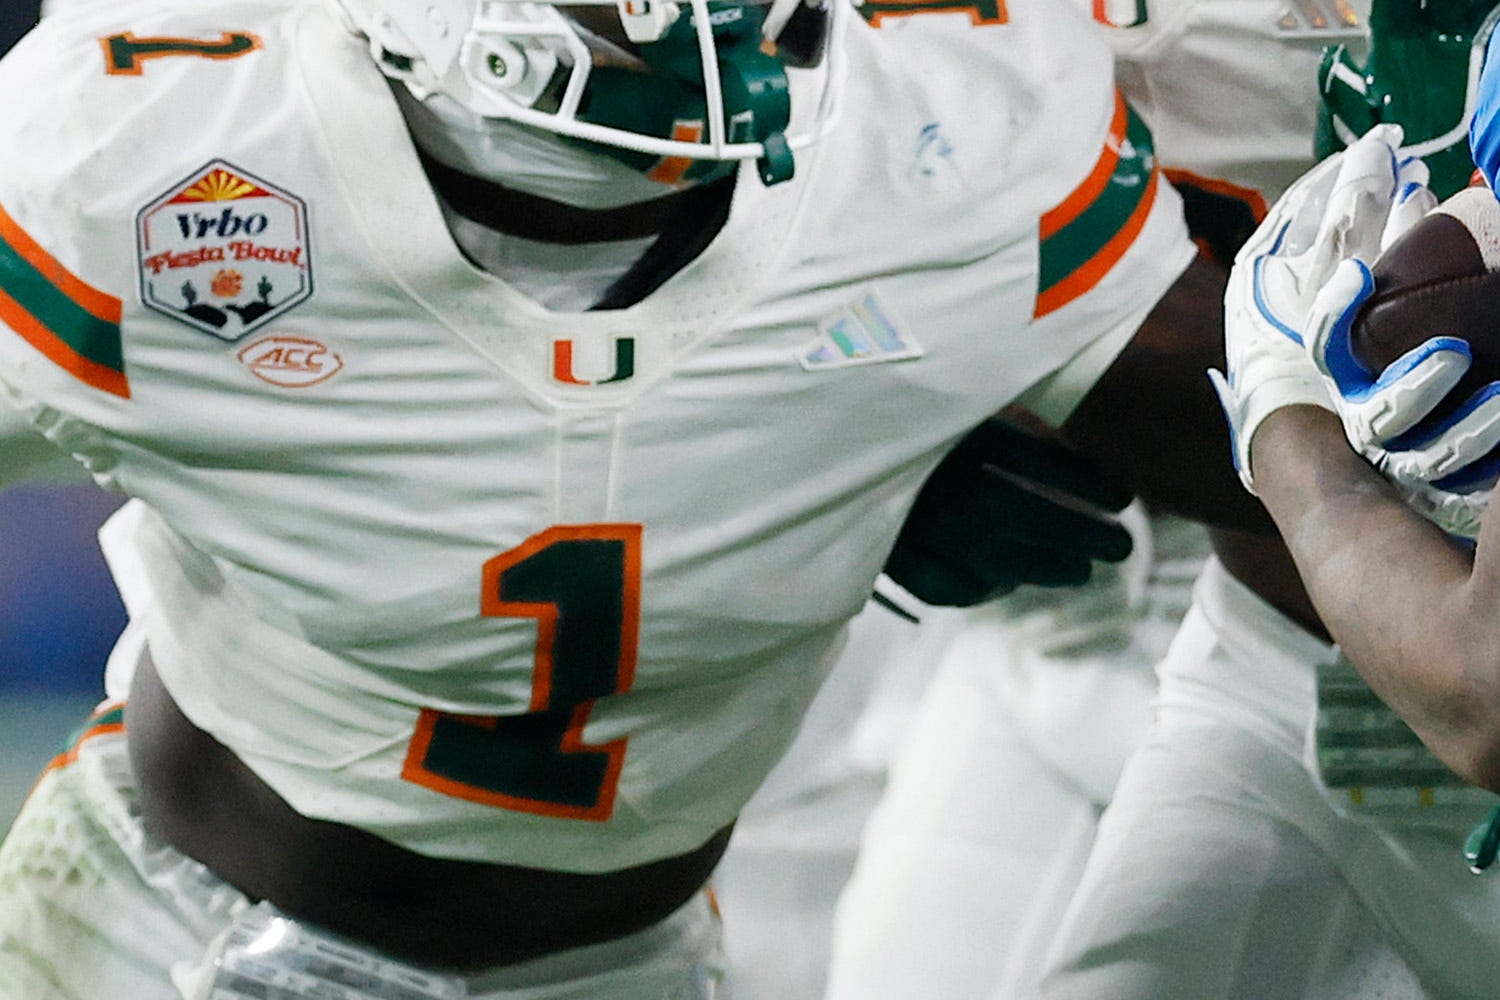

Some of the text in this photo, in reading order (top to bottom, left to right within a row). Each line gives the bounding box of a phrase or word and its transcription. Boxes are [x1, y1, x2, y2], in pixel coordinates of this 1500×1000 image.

[98, 30, 265, 76] 1
[177, 207, 268, 239] Vrbo
[144, 241, 305, 275] Fiesta Bowl
[251, 347, 327, 371] ACC
[553, 337, 635, 386] U
[400, 523, 643, 823] 1
